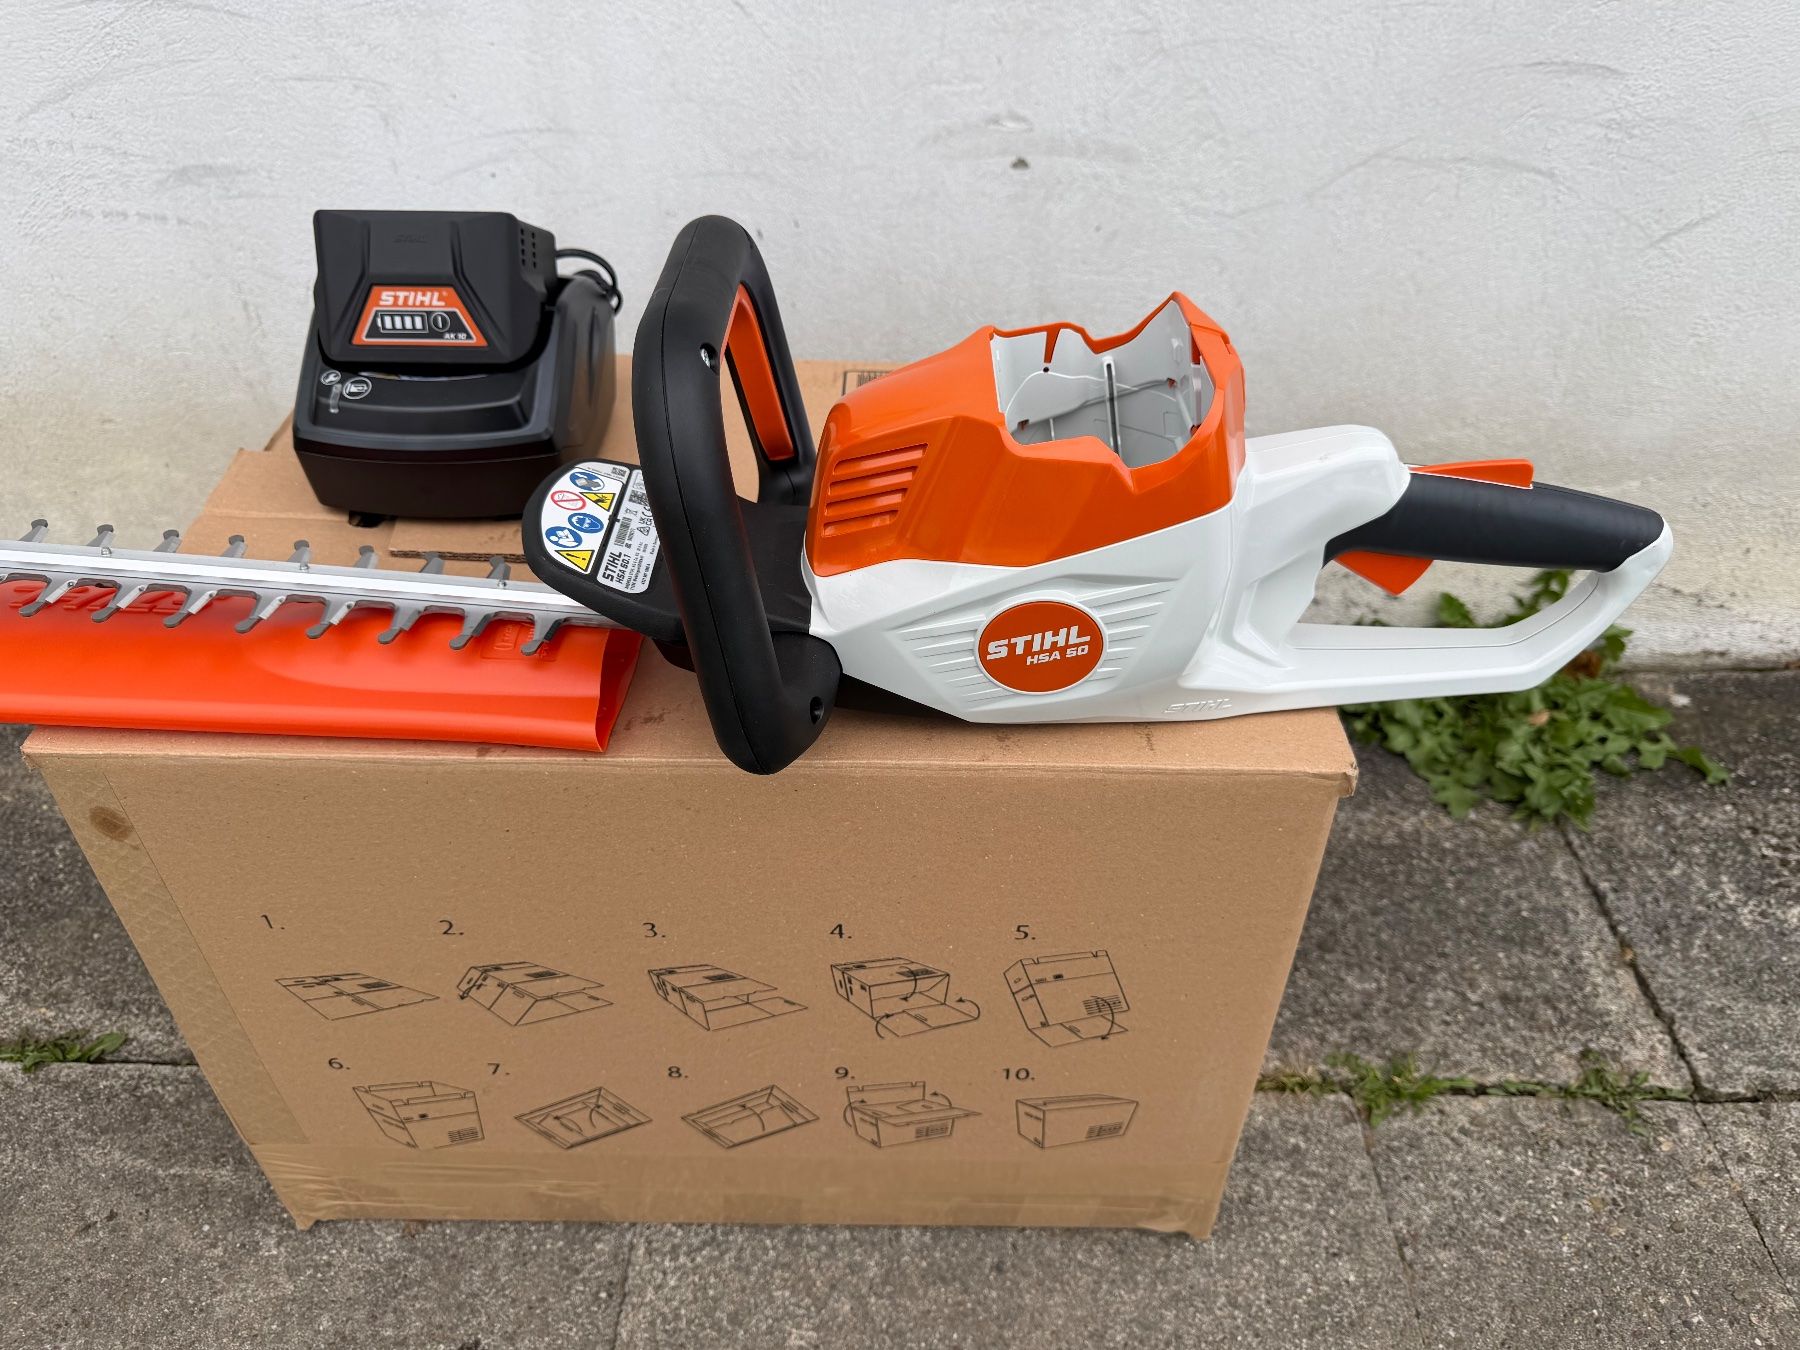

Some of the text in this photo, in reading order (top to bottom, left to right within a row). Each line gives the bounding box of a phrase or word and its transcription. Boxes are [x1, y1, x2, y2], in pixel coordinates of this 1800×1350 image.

[379, 291, 446, 306] STIHL
[443, 332, 456, 340] AK
[602, 551, 623, 582] STIHL
[615, 568, 627, 585] HSA
[986, 625, 1091, 660] STIHL
[1026, 644, 1089, 666] HSA 50
[261, 914, 285, 930] 1.
[439, 919, 465, 936] 2.
[642, 922, 667, 939] 3.
[829, 923, 853, 940] 4.
[1014, 924, 1037, 941] 5.
[327, 1057, 351, 1071] 6.
[487, 1062, 511, 1077] 7.
[667, 1065, 690, 1079] 8.
[834, 1066, 857, 1080] 9.
[1002, 1067, 1036, 1081] 10.
